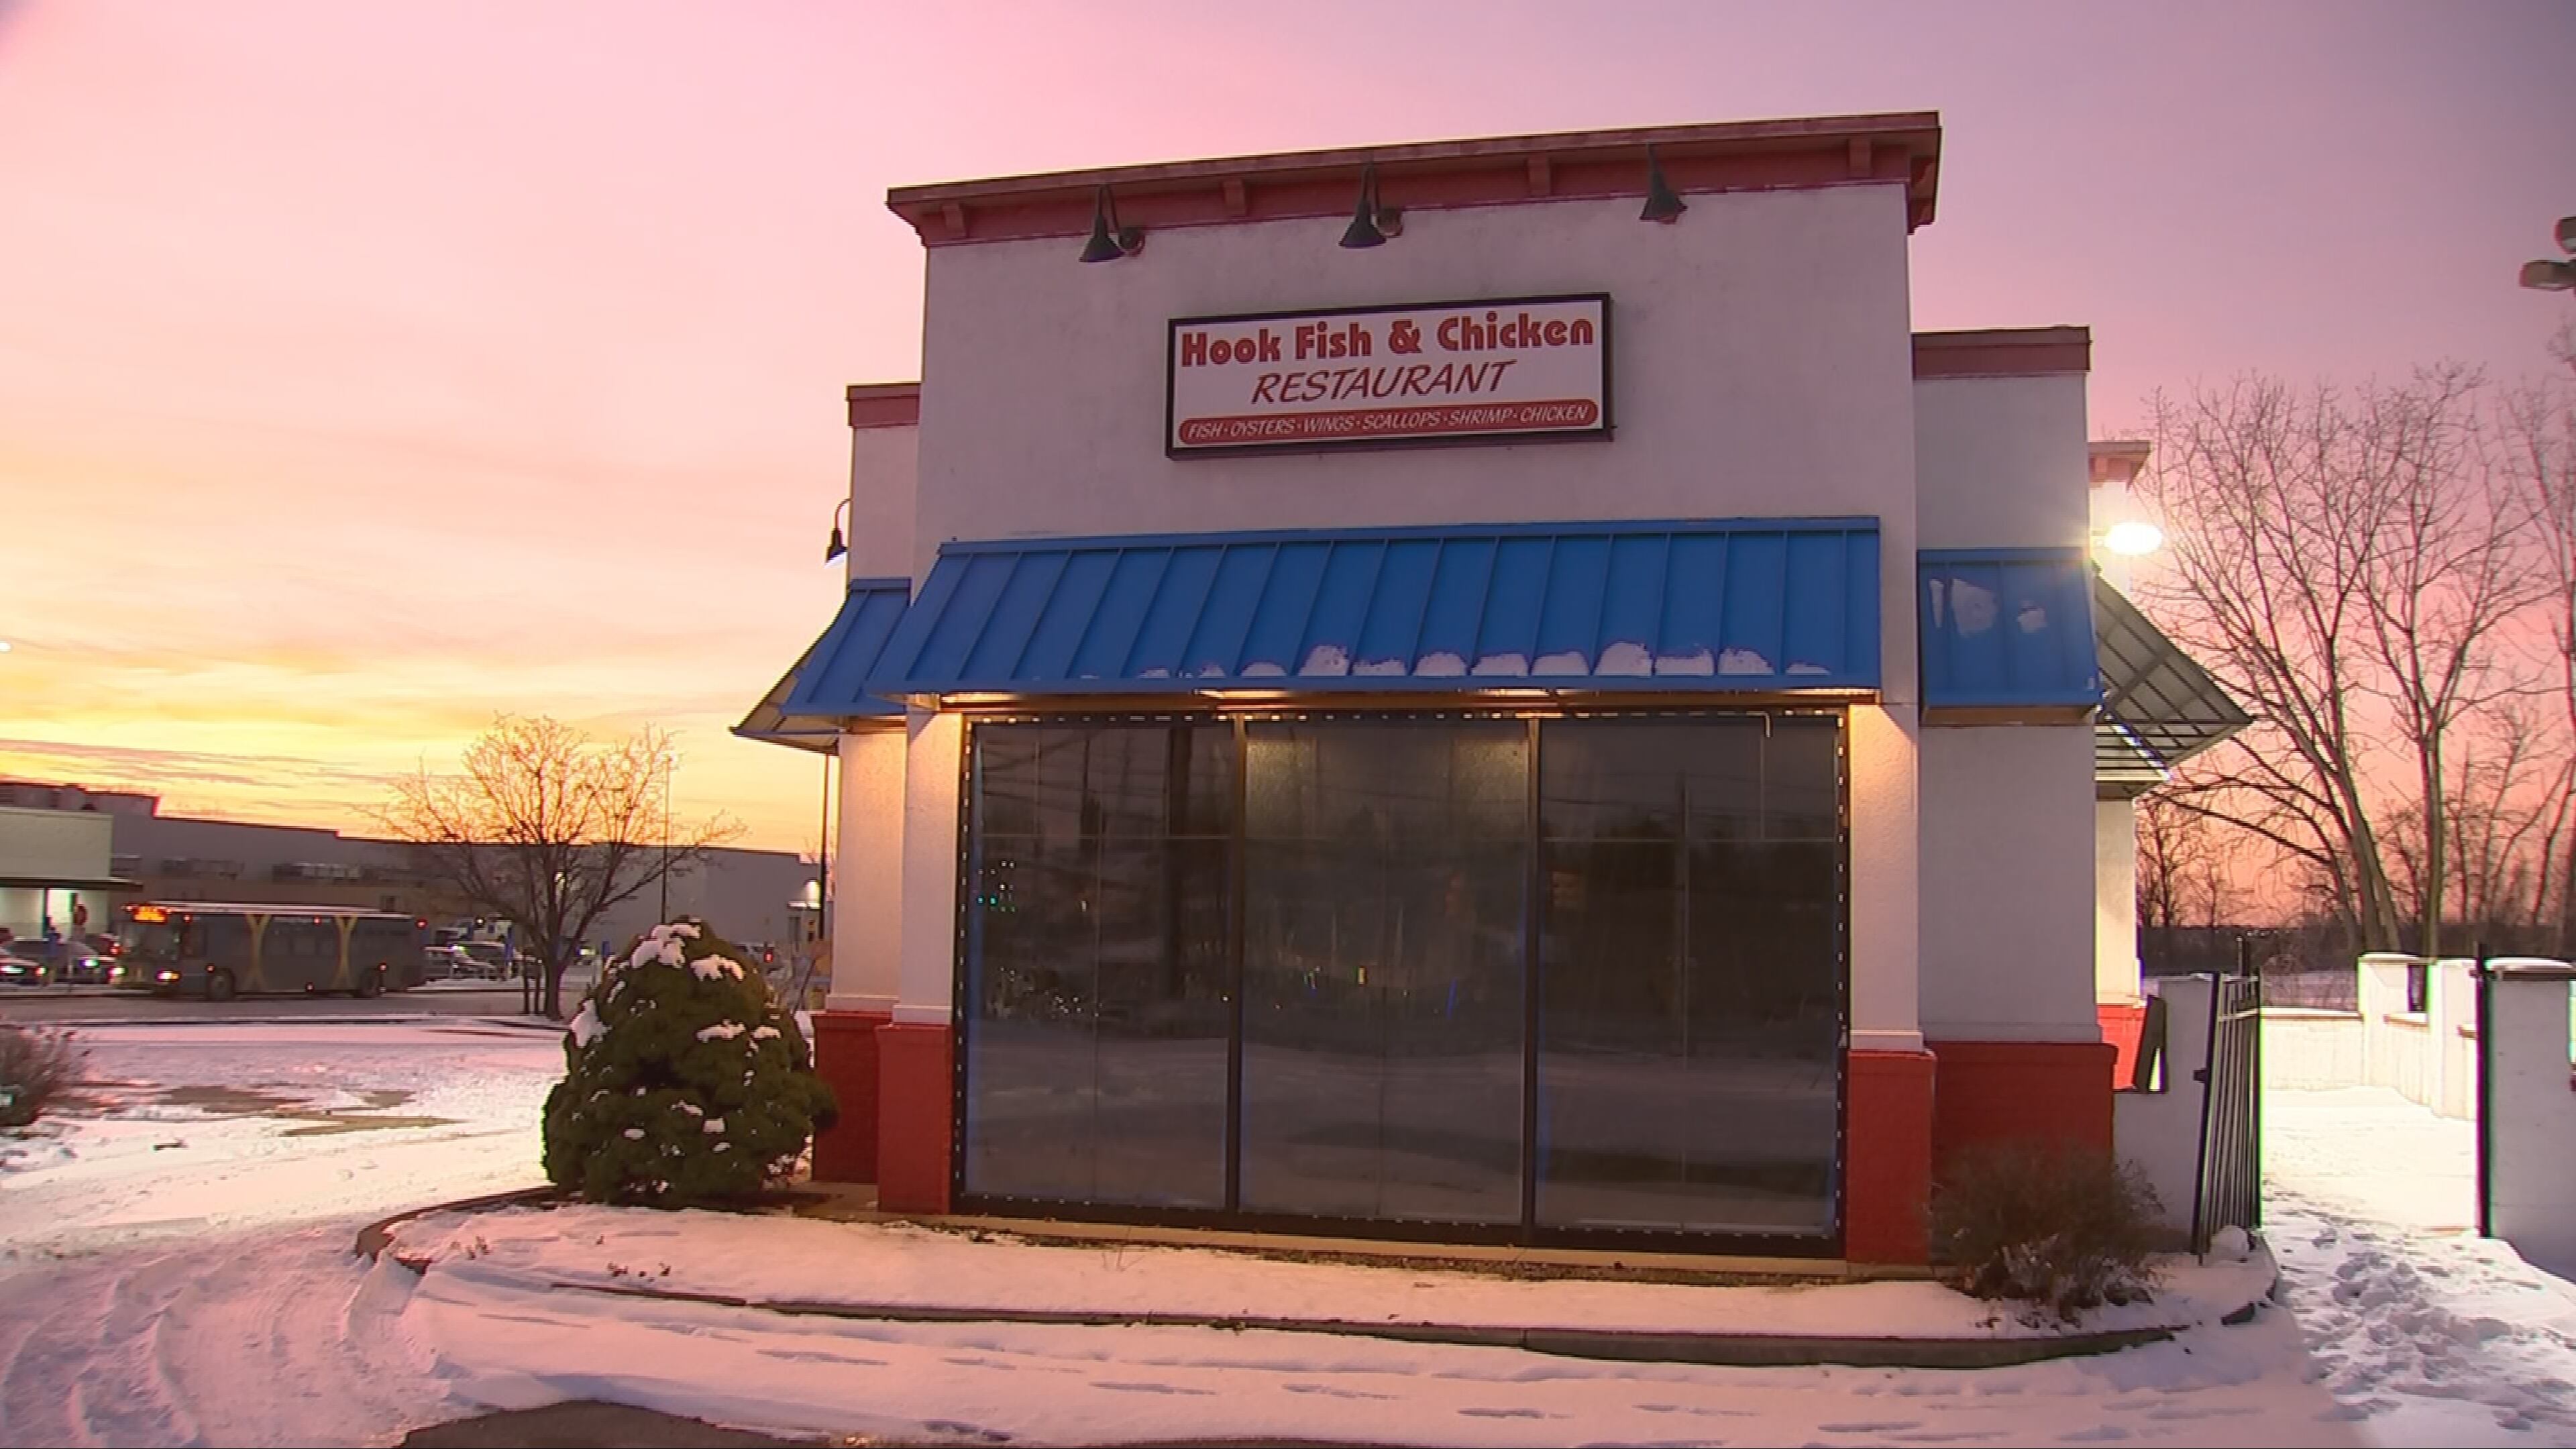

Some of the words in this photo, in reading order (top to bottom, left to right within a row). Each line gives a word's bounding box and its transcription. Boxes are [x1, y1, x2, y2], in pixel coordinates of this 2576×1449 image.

[1181, 327, 1281, 366] Hook
[1295, 321, 1372, 361] Fish
[1388, 319, 1422, 354] &
[1437, 311, 1593, 351] Chicken
[1250, 359, 1517, 404] RESTAURANT
[1187, 423, 1222, 439] FISH
[1229, 418, 1295, 437] OYSTERS
[1303, 415, 1354, 433] WINGS
[1362, 410, 1440, 430] SCALLOPS
[1446, 408, 1512, 425] SHRIMP
[1520, 405, 1589, 423] CHICKEN
